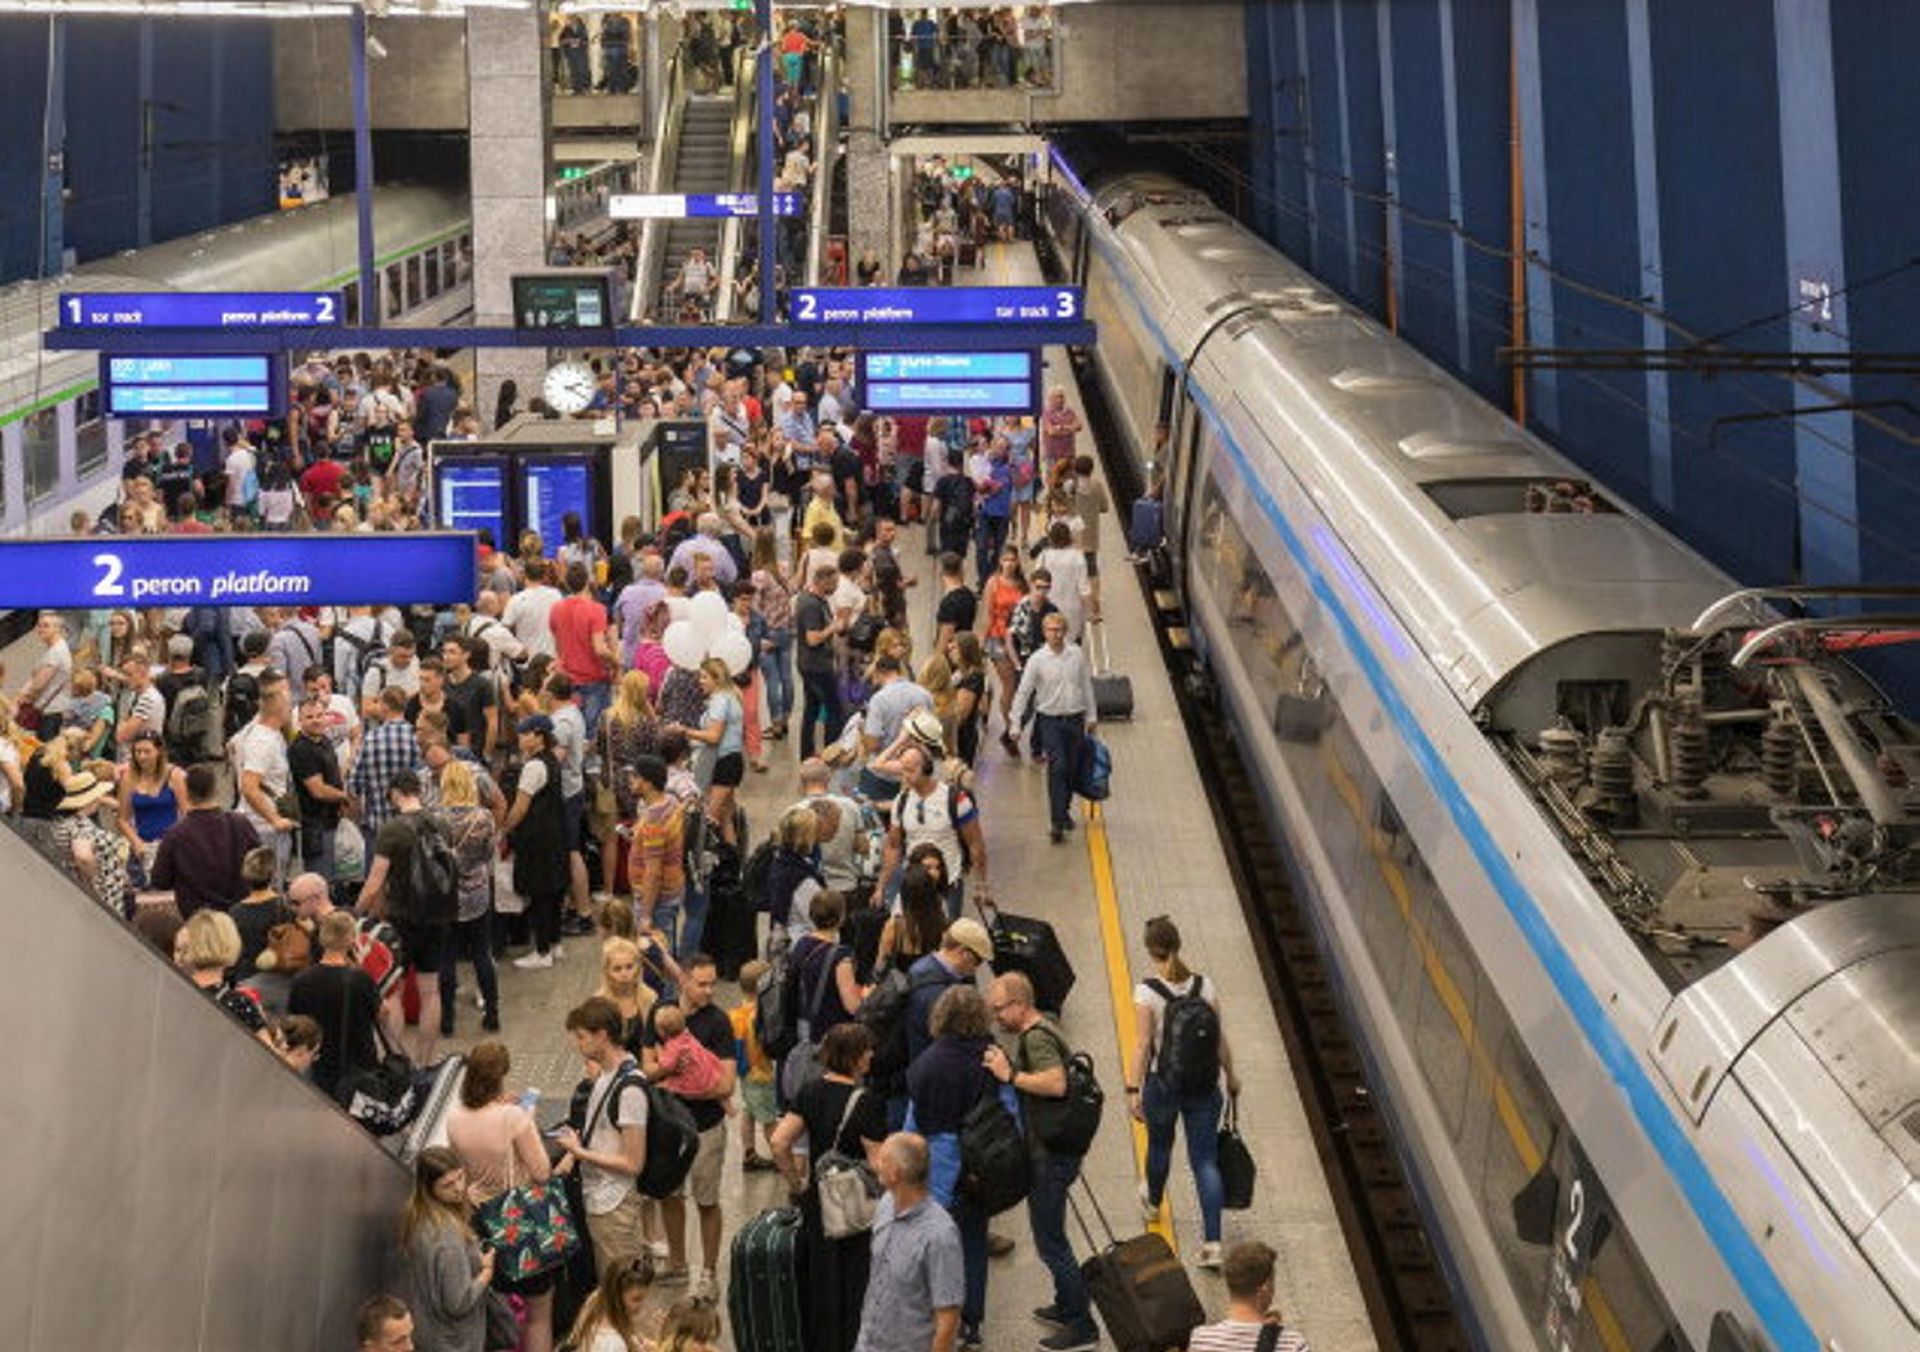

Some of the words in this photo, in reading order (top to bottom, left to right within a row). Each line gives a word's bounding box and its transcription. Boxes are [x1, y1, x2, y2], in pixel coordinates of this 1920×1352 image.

[67, 297, 82, 324] 1
[316, 297, 335, 321] 2
[798, 294, 817, 320] 2
[1056, 291, 1076, 318] 3
[93, 554, 124, 596] 2
[131, 578, 200, 599] peron
[209, 569, 310, 599] platform
